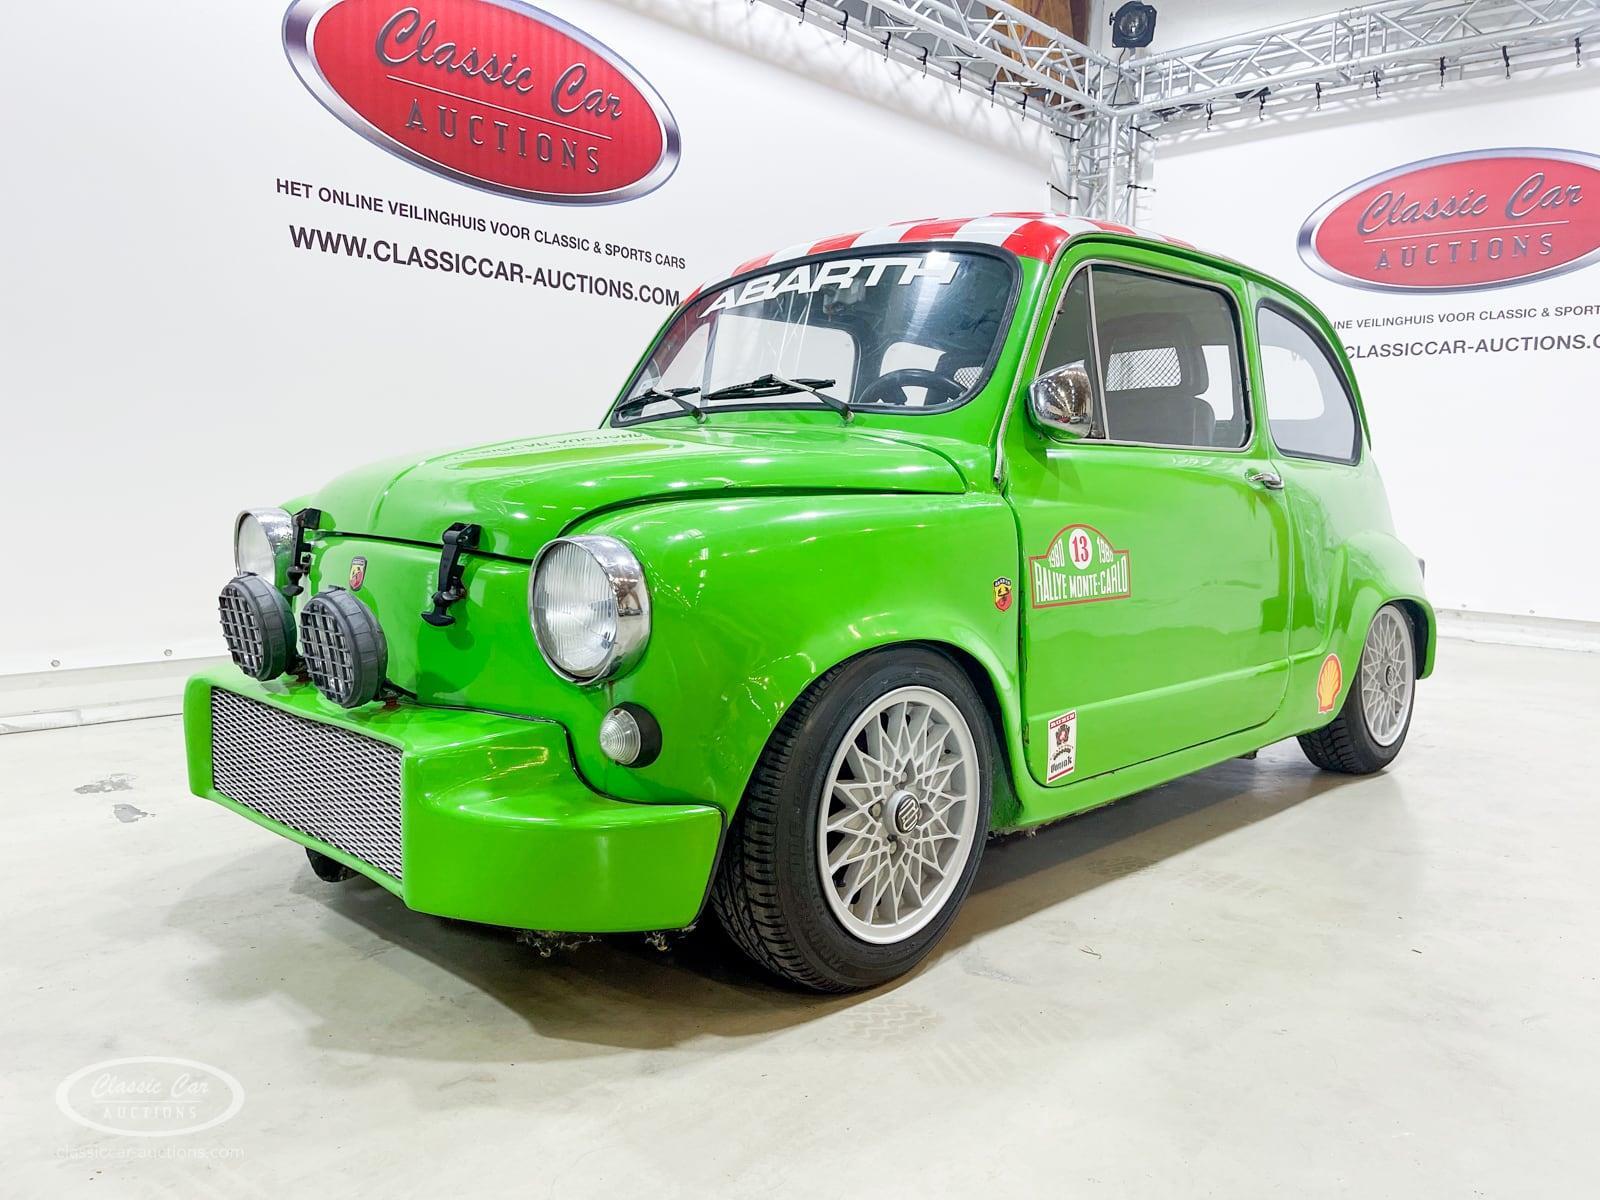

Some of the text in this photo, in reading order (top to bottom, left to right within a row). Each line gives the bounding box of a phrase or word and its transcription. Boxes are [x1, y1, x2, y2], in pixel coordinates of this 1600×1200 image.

[376, 7, 623, 120] Classic Car
[404, 98, 600, 174] AUCTIONS
[276, 178, 686, 270] HET ONLINE VEILINGHUIS VOOR CLASSIC & SPORTS CARS
[1358, 172, 1584, 235] Classic Car
[289, 224, 681, 308] WWW.CLASSICCAR-AUCTIONS.COM
[1374, 233, 1553, 270] AUCTIONS
[698, 256, 961, 319] ABARTH
[1332, 304, 1600, 330] INE VEILINGHUIS VOOR CLASSIC & SPORT
[1072, 536, 1089, 562] 13
[1034, 561, 1068, 602] RALLYE
